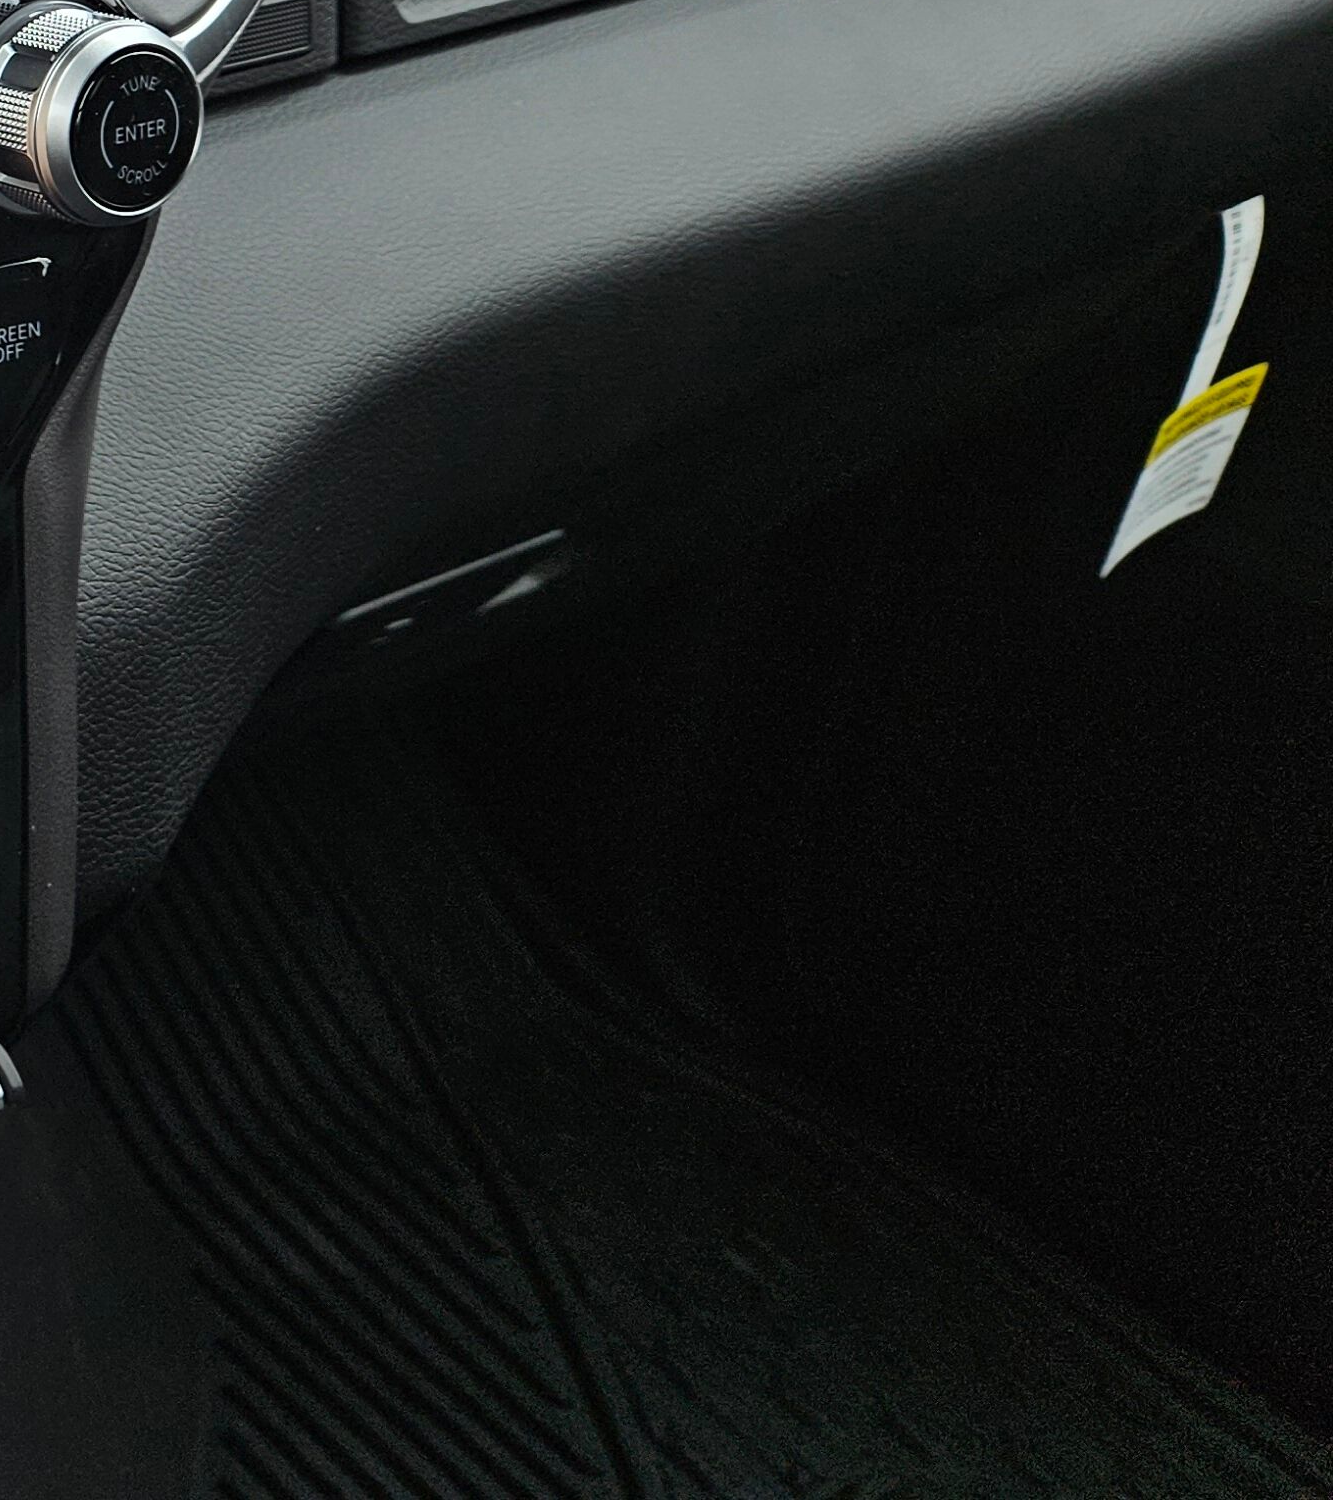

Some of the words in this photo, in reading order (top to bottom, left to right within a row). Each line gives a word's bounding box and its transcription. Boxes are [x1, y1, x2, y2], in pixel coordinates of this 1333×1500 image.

[120, 75, 160, 96] TUNE
[115, 118, 166, 145] ENTER
[117, 160, 168, 184] SCROLL
